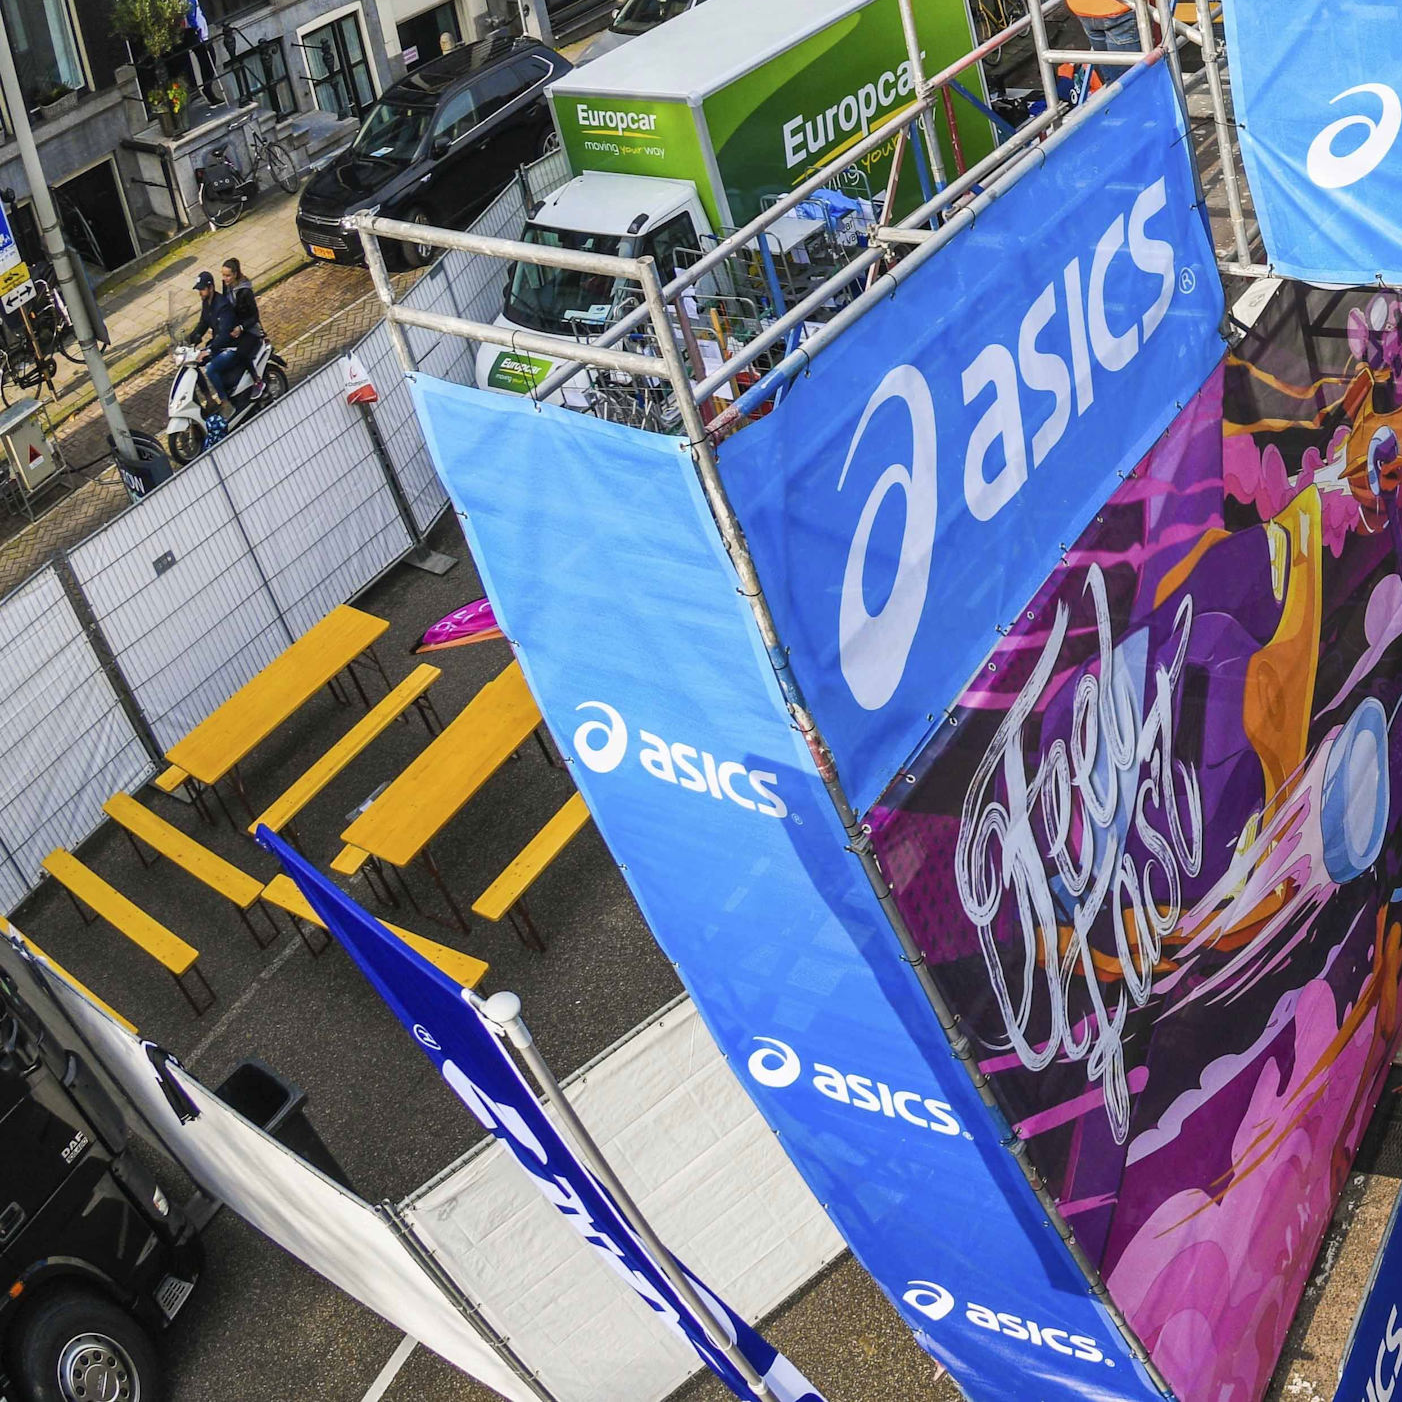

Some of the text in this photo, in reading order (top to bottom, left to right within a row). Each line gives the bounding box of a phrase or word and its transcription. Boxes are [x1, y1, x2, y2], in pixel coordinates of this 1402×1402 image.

[576, 103, 657, 136] Europcar
[584, 140, 665, 159] moving your way
[501, 357, 542, 375] Europcar
[962, 175, 1178, 524] asics
[639, 728, 789, 819] asics
[812, 1062, 962, 1137] asics
[60, 1129, 85, 1159] DAF
[966, 1301, 1106, 1364] asics
